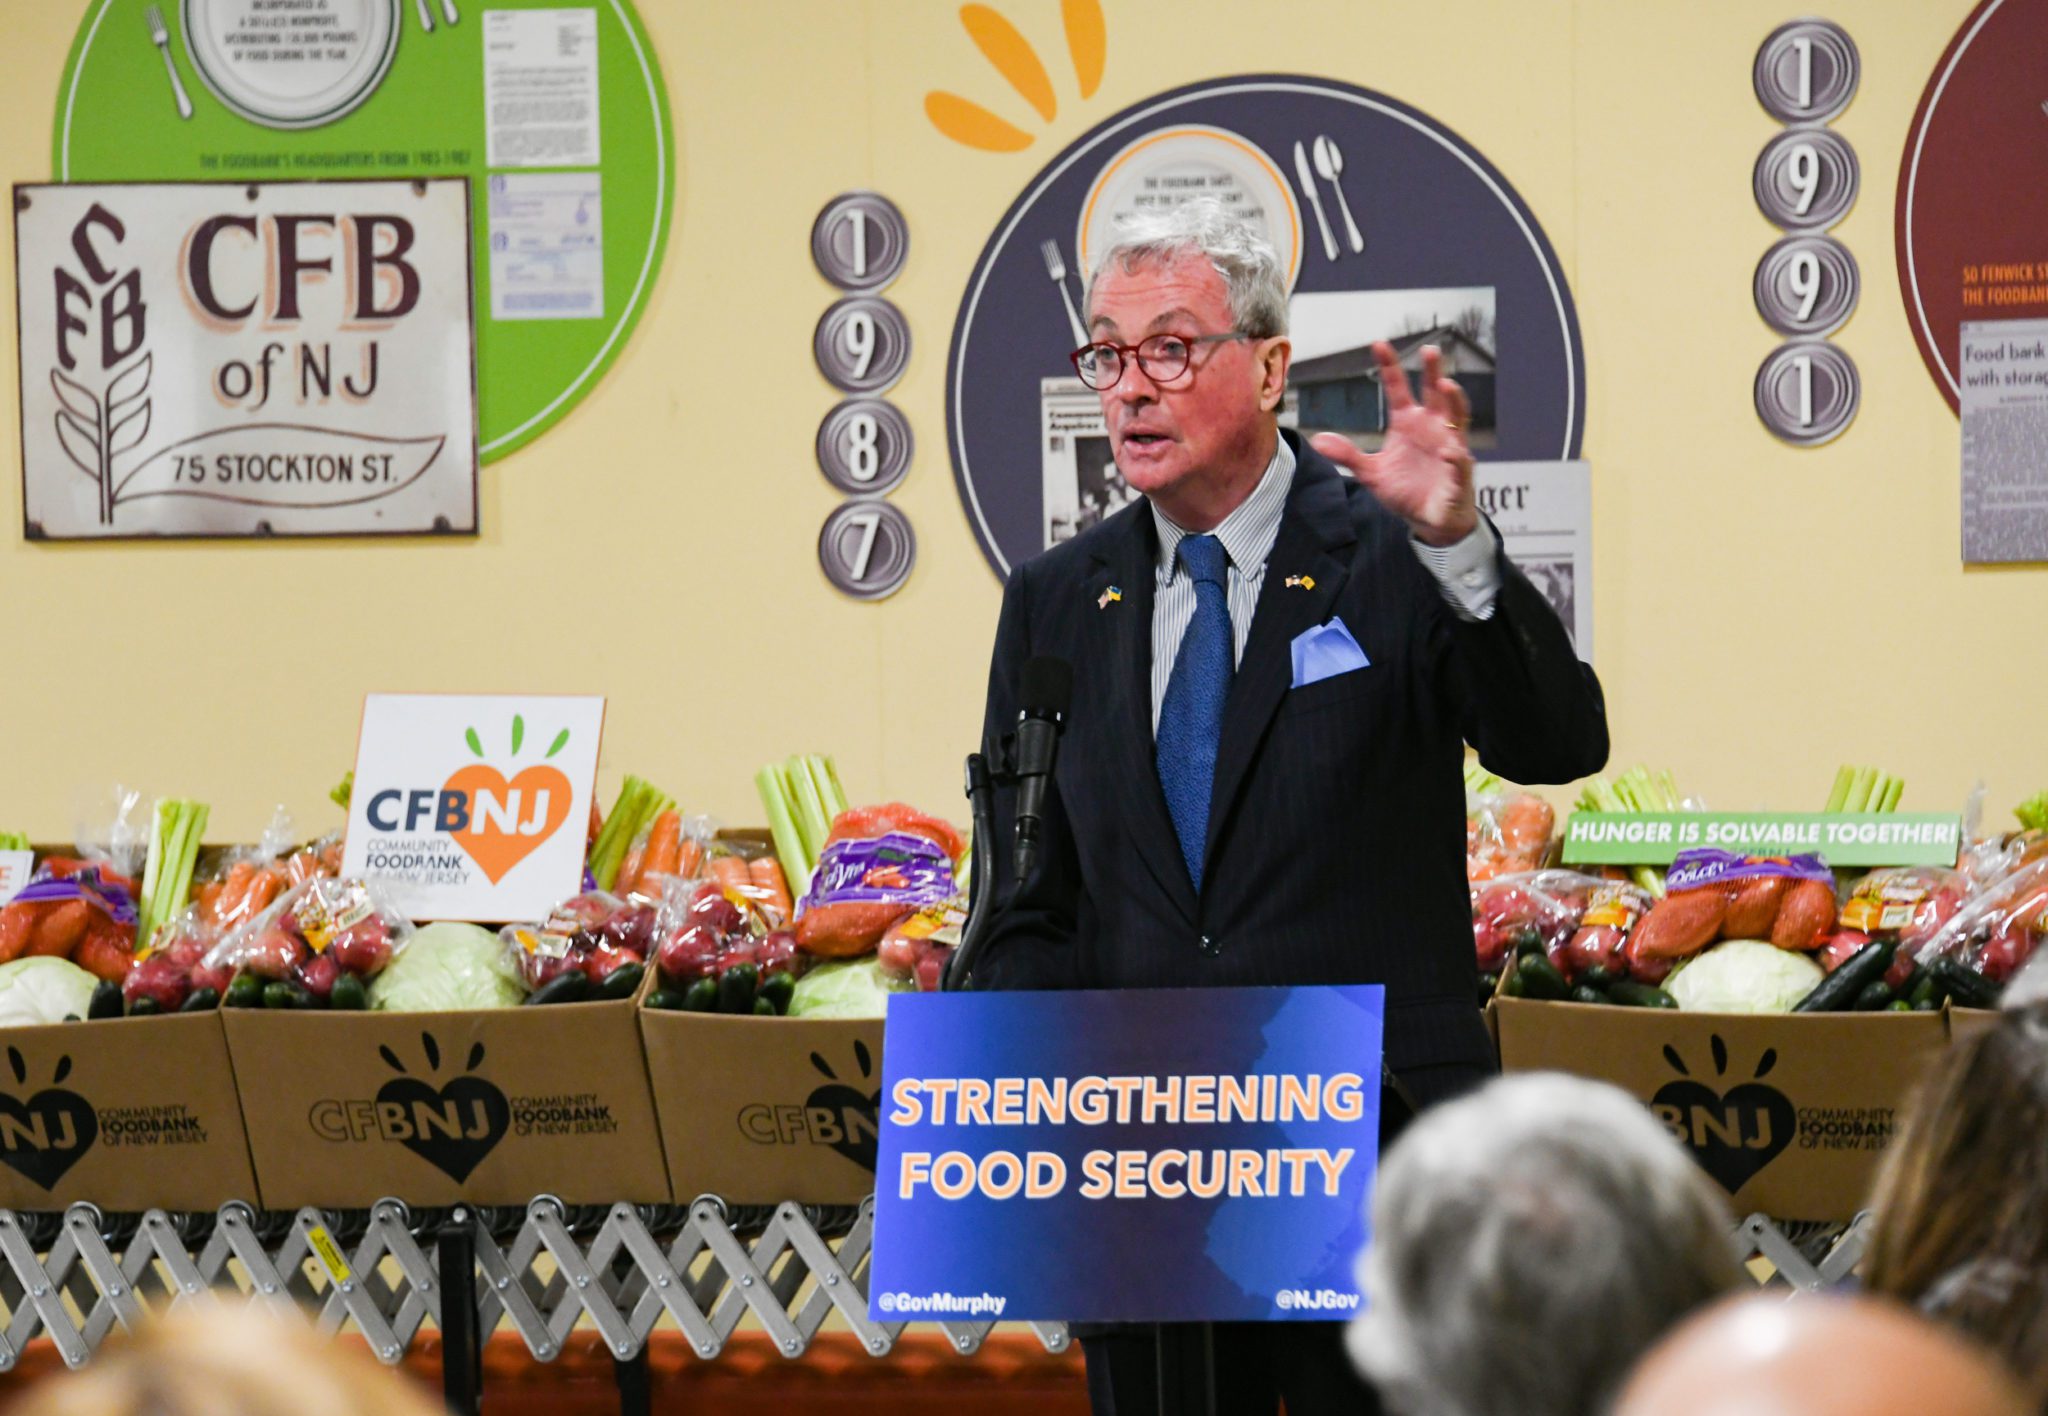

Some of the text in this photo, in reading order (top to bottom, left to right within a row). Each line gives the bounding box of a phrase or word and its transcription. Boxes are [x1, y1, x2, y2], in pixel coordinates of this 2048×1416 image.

[178, 213, 421, 330] CFB
[1982, 262, 2033, 282] FENWICK
[1963, 284, 2048, 306] THE FOODBAN
[1966, 340, 2045, 362] Food bank
[219, 342, 378, 412] of NJ
[1967, 367, 2048, 387] with storag
[172, 456, 398, 484] 75 STOCKTON ST.
[1480, 484, 1530, 516] ger
[366, 787, 551, 838] CFBNJ
[1570, 821, 1957, 845] HUNGER IS SOLVABLE TOGETHER!
[367, 839, 450, 853] COMMUNITY
[366, 854, 463, 869] FOODBANK
[510, 1093, 598, 1109] COMMUNITY
[889, 1073, 1364, 1126] STRENGTHENING
[98, 1104, 188, 1120] COMMUNITY
[308, 1099, 491, 1143] CFBNJ
[513, 1106, 612, 1124] FOODBANK
[1798, 1106, 1896, 1121] COMMUNITY
[101, 1116, 201, 1136] FOODBANK
[515, 1119, 619, 1137] OF NEW JERSEY
[737, 1103, 880, 1145] CFBN
[1652, 1103, 1774, 1149] BNJ
[1800, 1120, 1895, 1137] FOODBAN
[103, 1129, 208, 1147] OF NEW JERSEY
[1800, 1136, 1819, 1150] OF
[1823, 1136, 1861, 1151] NEW
[899, 1148, 1355, 1200] FOOD SECURITY
[878, 1293, 1006, 1315] @GovMurphy
[1276, 1290, 1360, 1310] @NJGov
